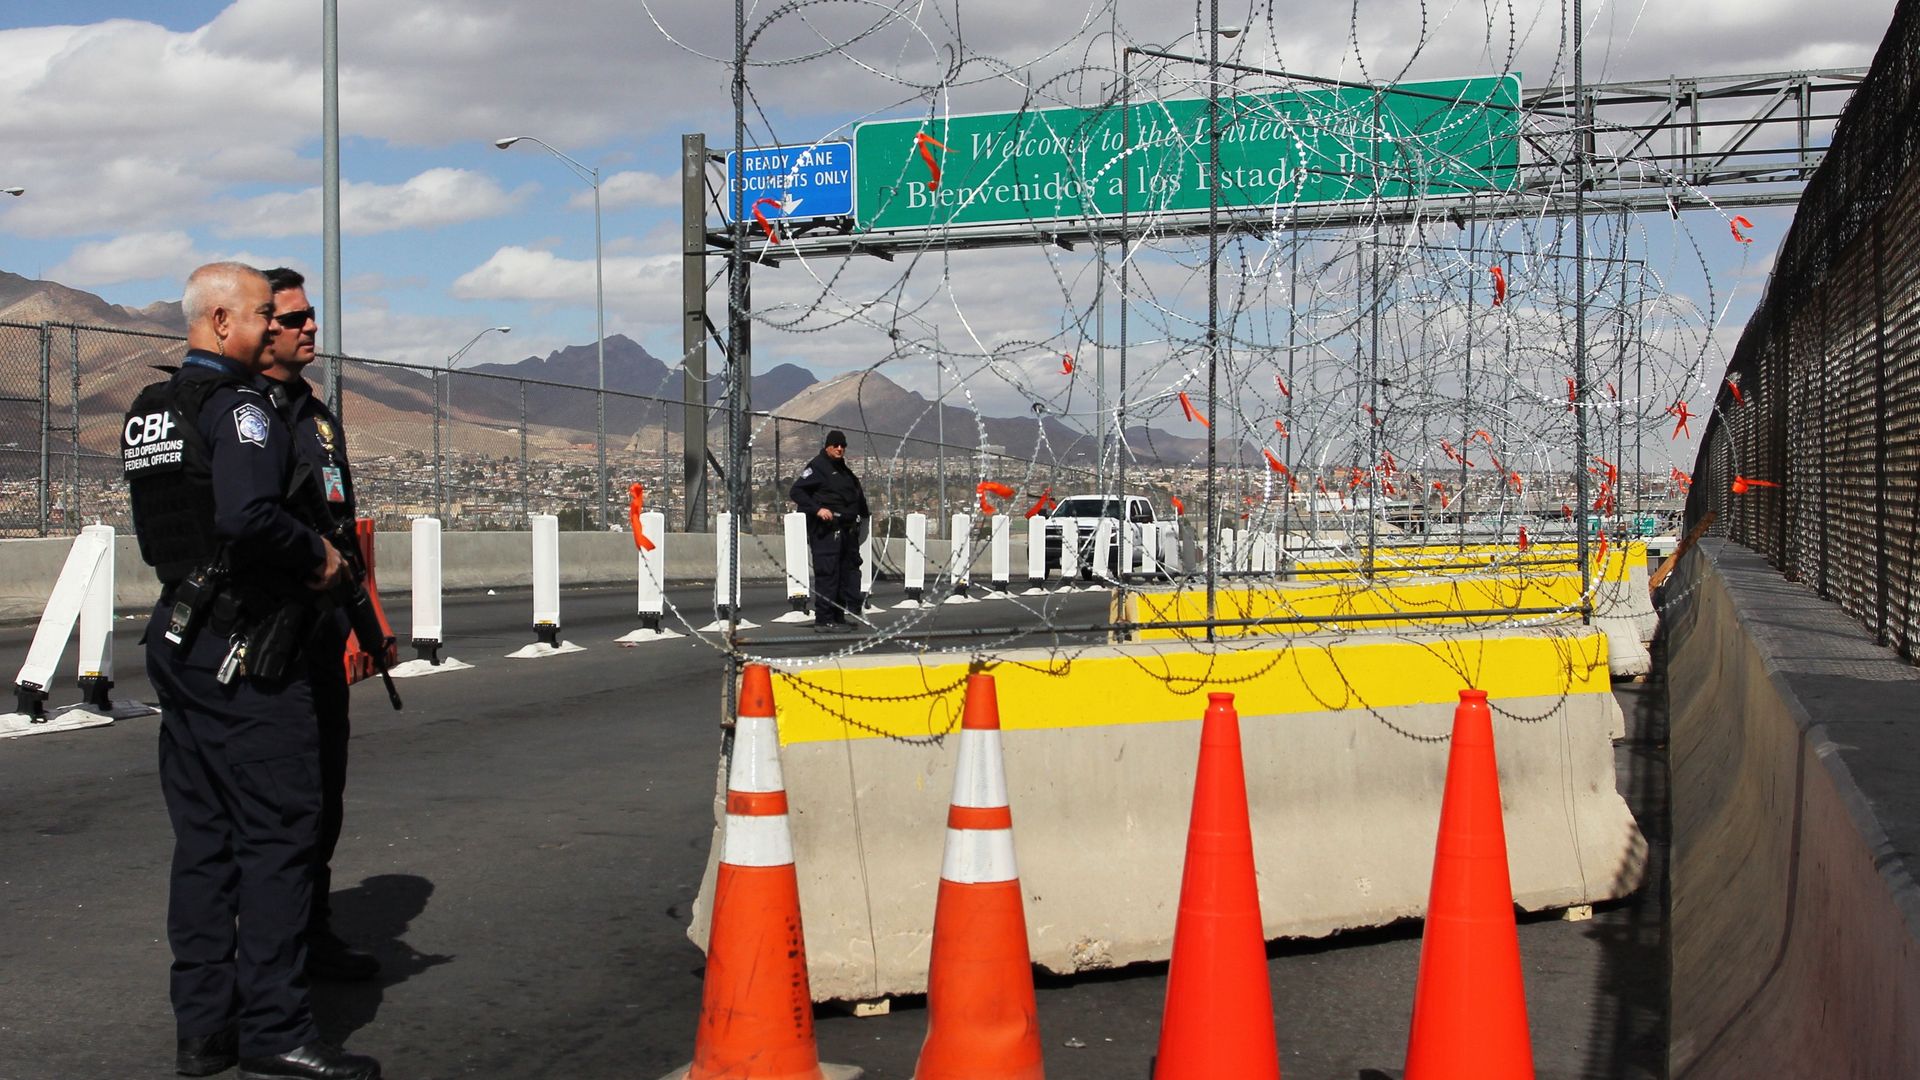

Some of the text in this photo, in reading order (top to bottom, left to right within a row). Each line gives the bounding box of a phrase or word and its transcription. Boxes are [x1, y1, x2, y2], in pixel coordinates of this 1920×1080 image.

[971, 108, 1388, 160] Welcome to the United States
[745, 155, 789, 172] READY
[730, 169, 849, 193] DOCUMETS ONLY
[906, 172, 1096, 209] Bienvenidos
[1109, 177, 1123, 195] a
[1138, 167, 1181, 194] los
[1196, 158, 1323, 190] Estados
[124, 439, 184, 459] FIELD OPERATIONS
[124, 451, 182, 471] FEDERAL OFFICER
